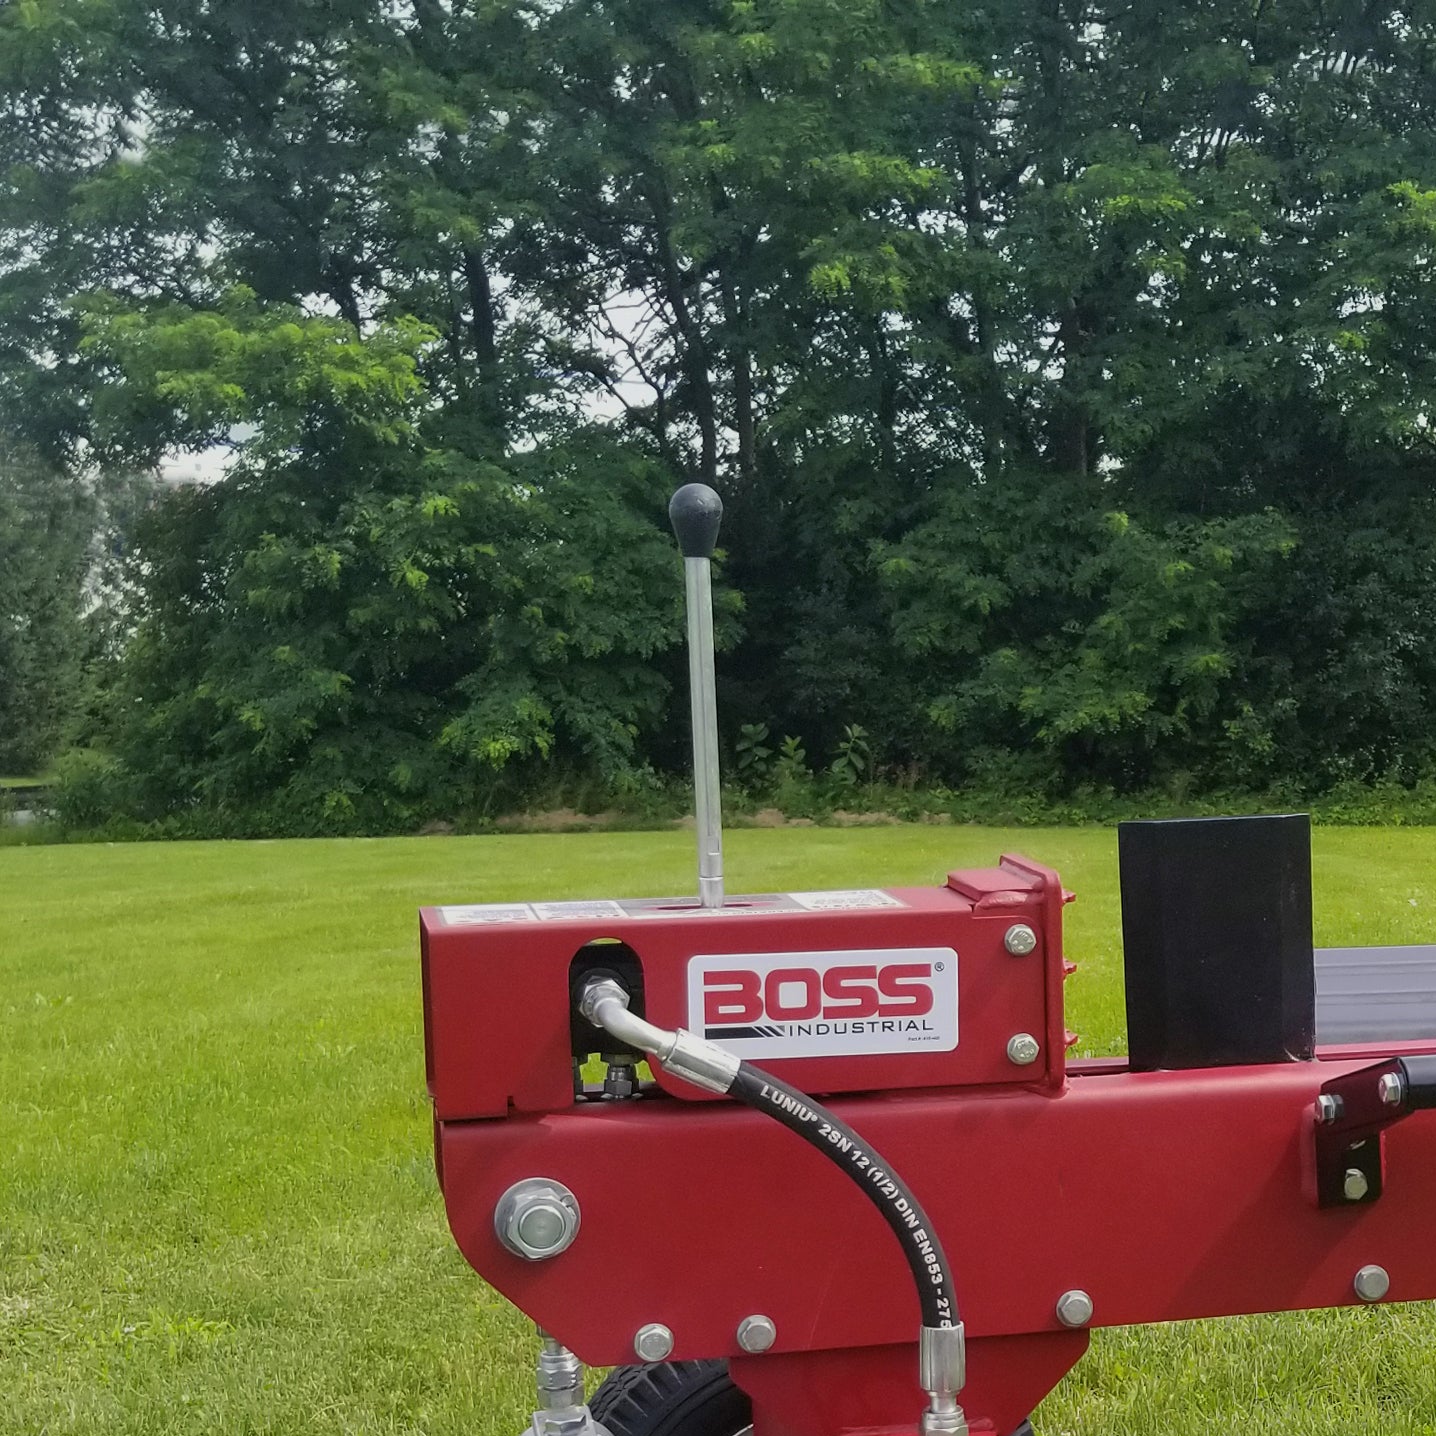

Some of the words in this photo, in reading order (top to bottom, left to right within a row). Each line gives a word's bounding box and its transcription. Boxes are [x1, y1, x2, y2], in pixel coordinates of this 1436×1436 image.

[703, 963, 934, 1024] BOSS
[789, 1019, 934, 1037] INDUSTRIAL
[818, 1123, 852, 1153] 2SN
[867, 1167, 900, 1200] (1/2)
[894, 1198, 919, 1229] DIN
[912, 1228, 943, 1285] EN853
